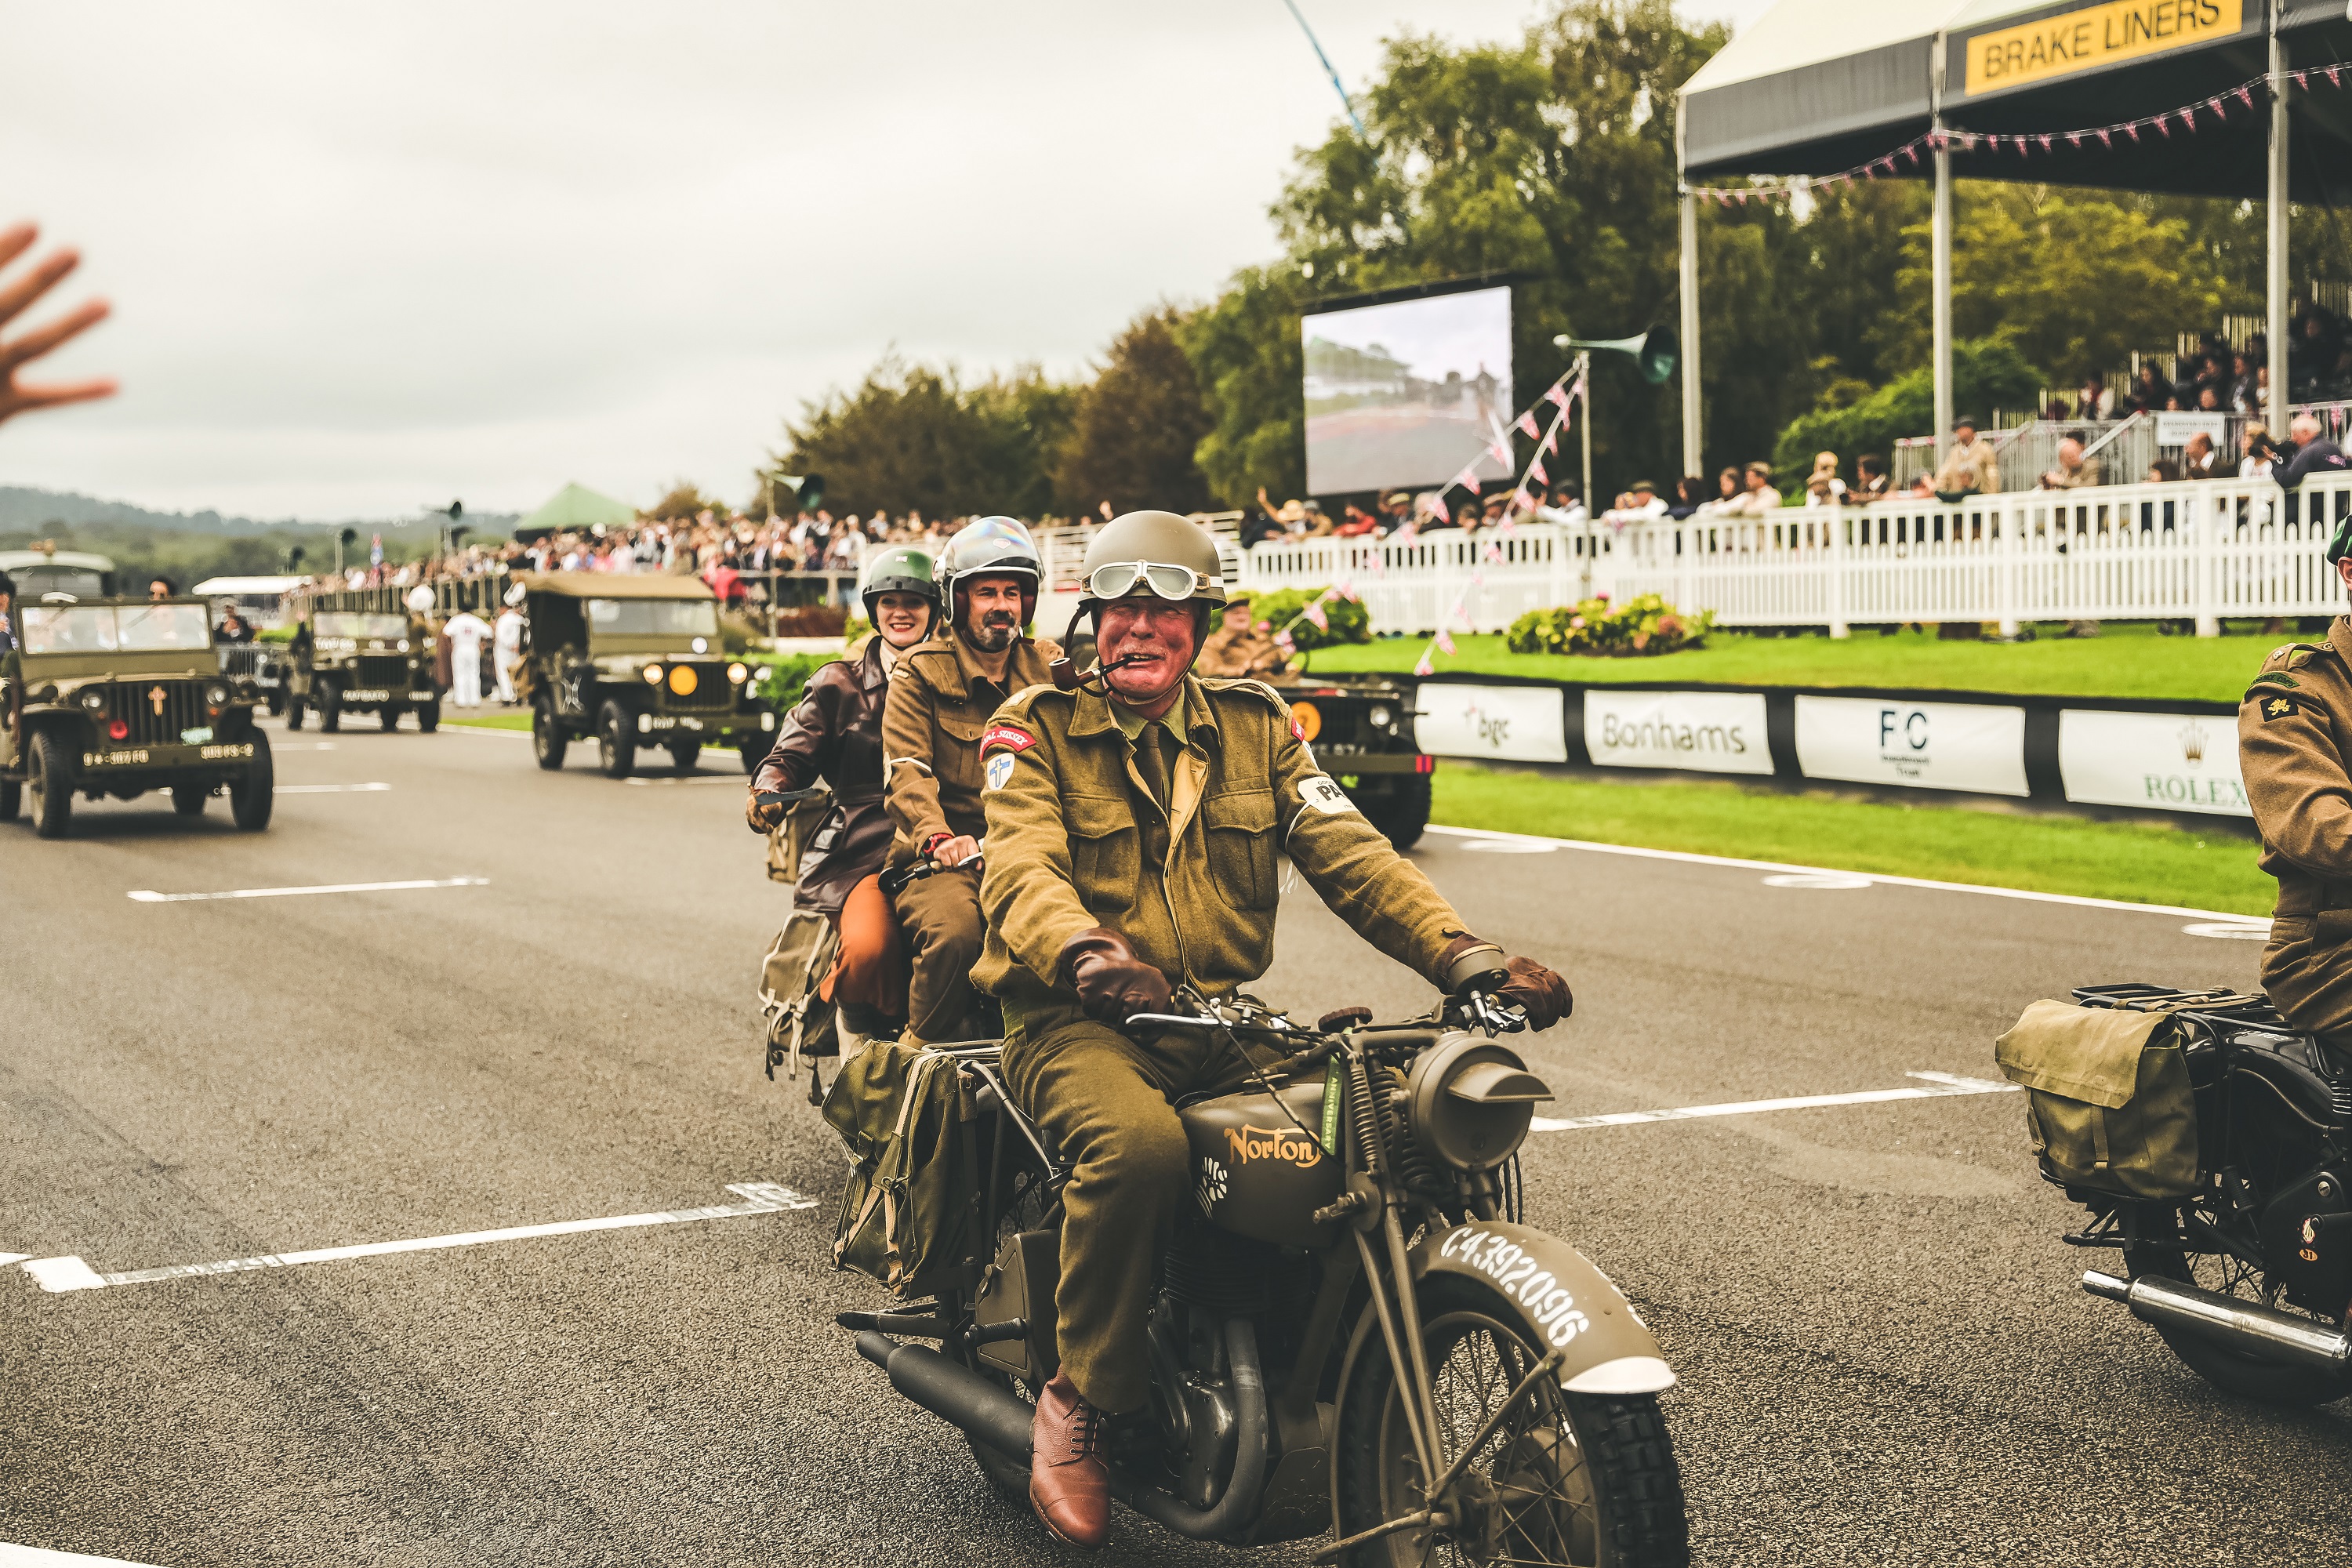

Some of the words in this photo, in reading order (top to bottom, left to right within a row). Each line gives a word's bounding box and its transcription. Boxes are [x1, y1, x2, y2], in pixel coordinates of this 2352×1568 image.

[1985, 21, 2091, 79] BRAKE
[2105, 0, 2220, 50] LINERS
[997, 730, 1028, 746] SUSSEX
[1603, 712, 1746, 753] Bonhams
[1316, 784, 1346, 801] PA
[2143, 773, 2247, 807] ROLEX
[1324, 1076, 1338, 1149] ANNIVERSARY
[1224, 1123, 1322, 1168] Norton
[1440, 1227, 1589, 1347] C4392096
